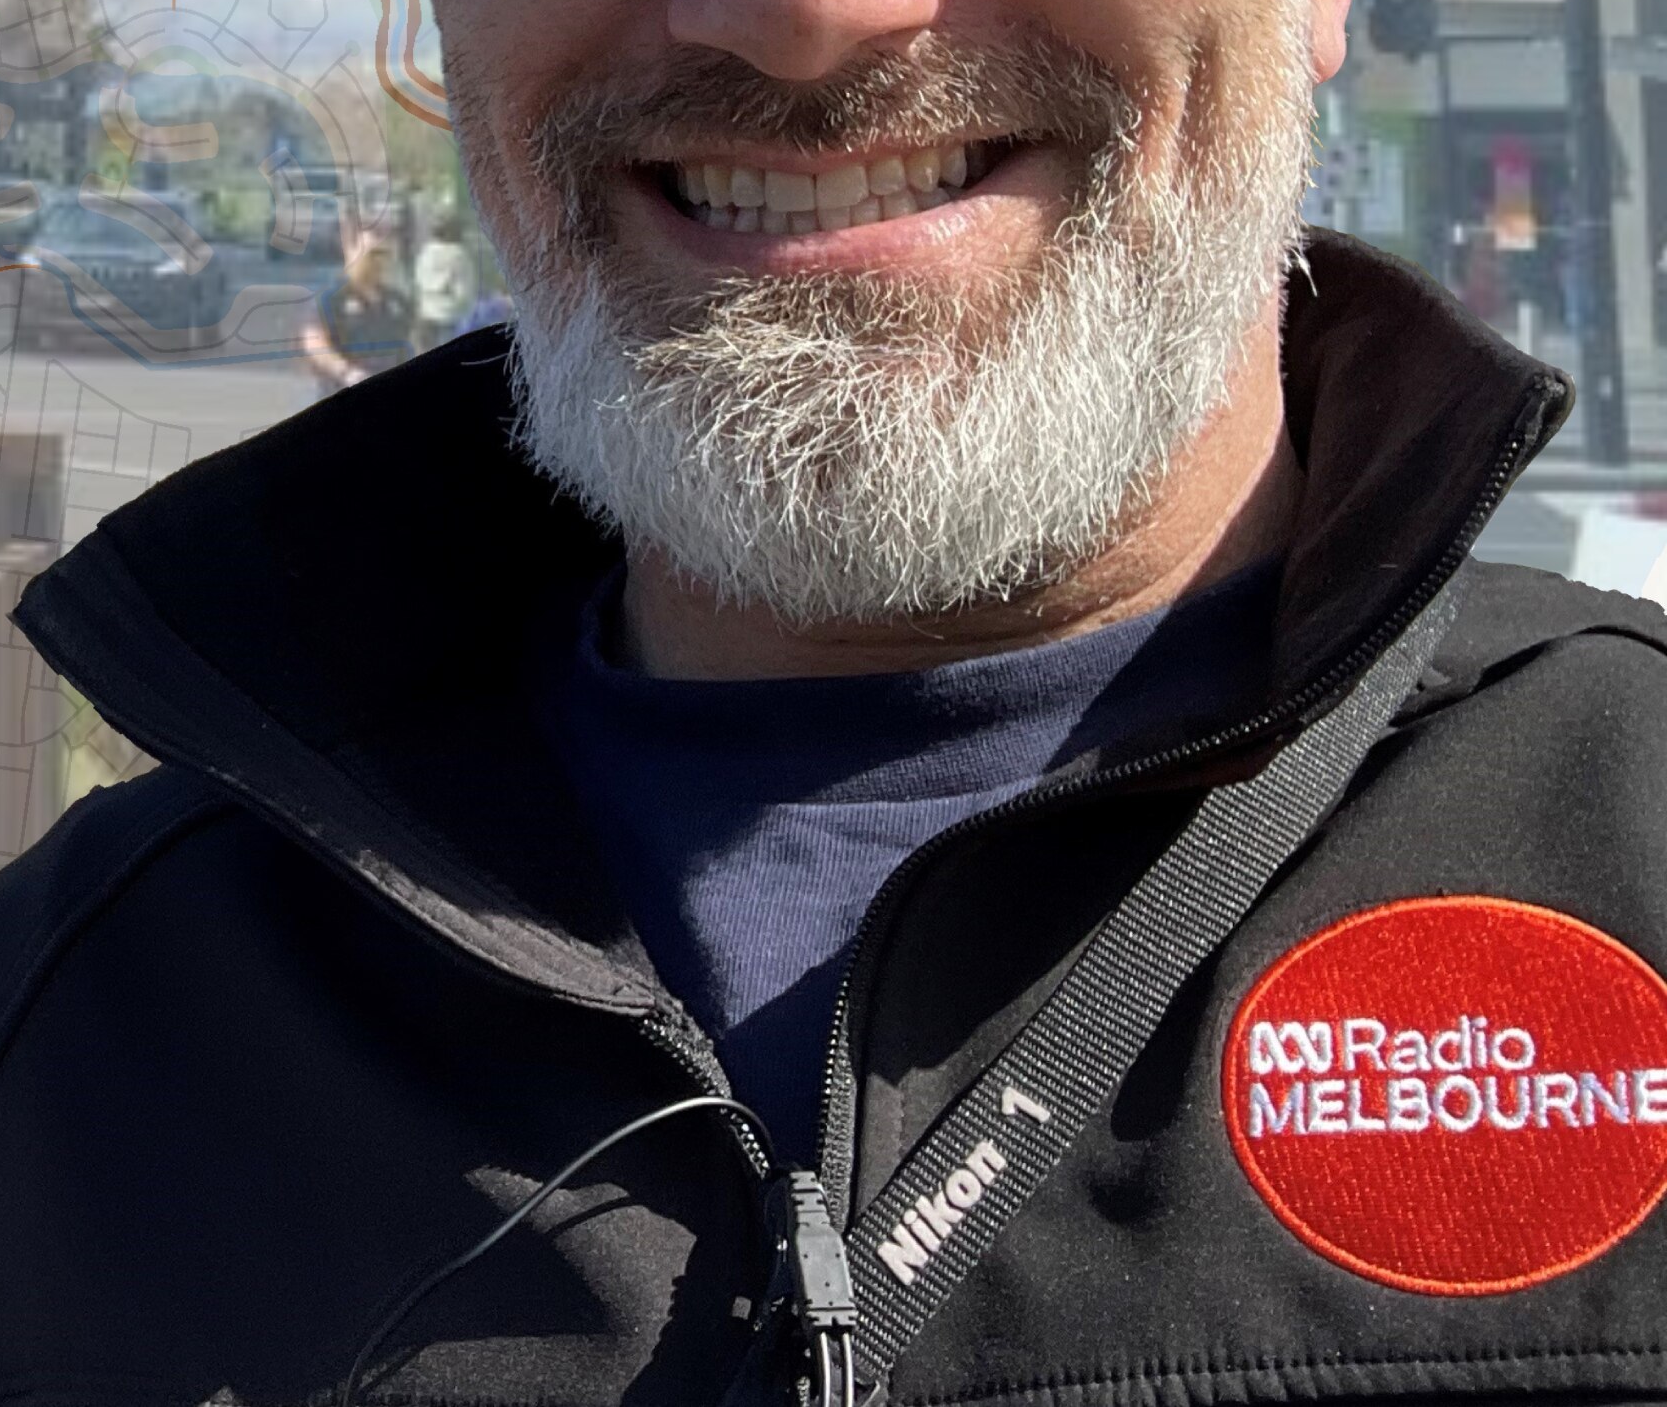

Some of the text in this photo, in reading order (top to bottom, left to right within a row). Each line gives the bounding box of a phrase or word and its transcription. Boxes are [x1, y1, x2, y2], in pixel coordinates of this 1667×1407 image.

[1343, 1015, 1536, 1072] Radio
[1249, 1068, 1667, 1138] MELBOURNE
[877, 1086, 1051, 1286] Nikon 1
